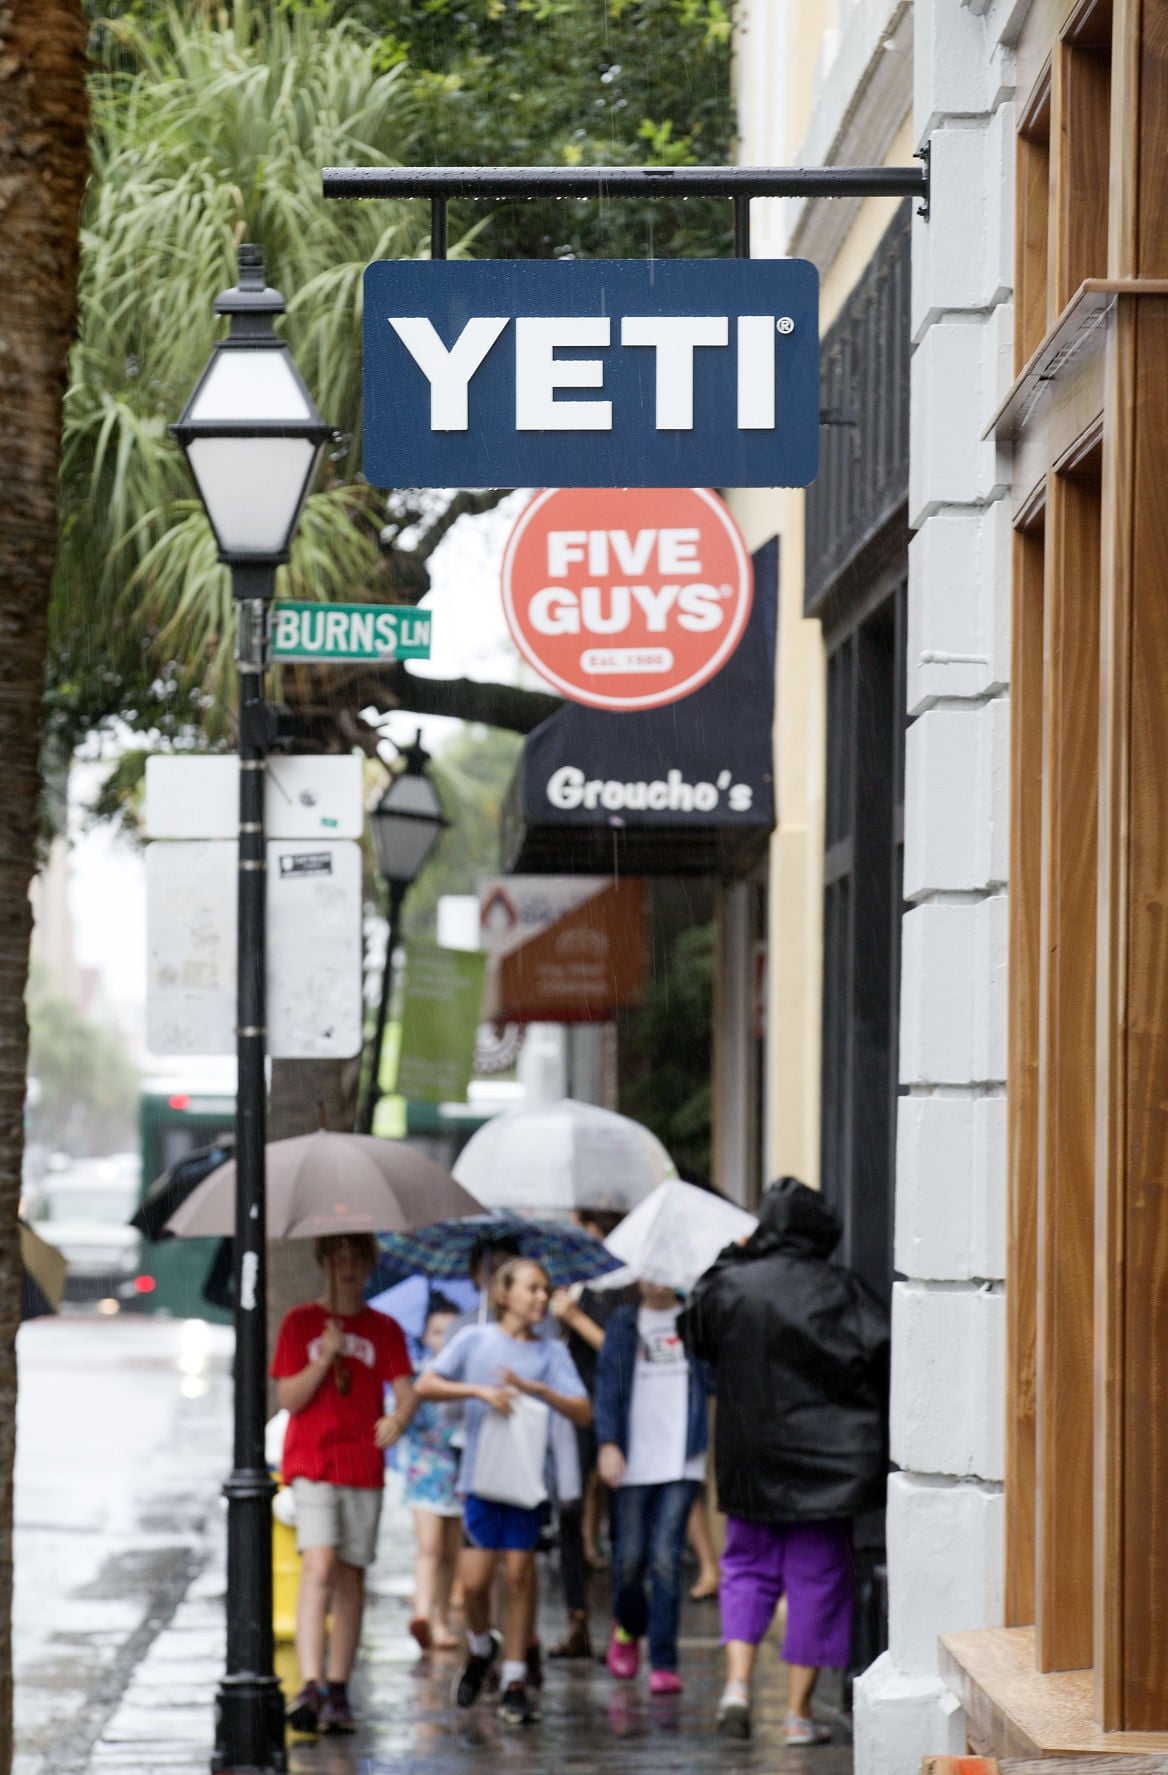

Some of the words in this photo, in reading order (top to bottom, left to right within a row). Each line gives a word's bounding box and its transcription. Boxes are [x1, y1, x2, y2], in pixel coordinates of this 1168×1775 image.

[547, 528, 702, 577] FIVE
[276, 609, 398, 653] BURNS
[401, 619, 431, 647] LN
[528, 583, 724, 635] GUYS
[547, 766, 753, 812] Groucho's
